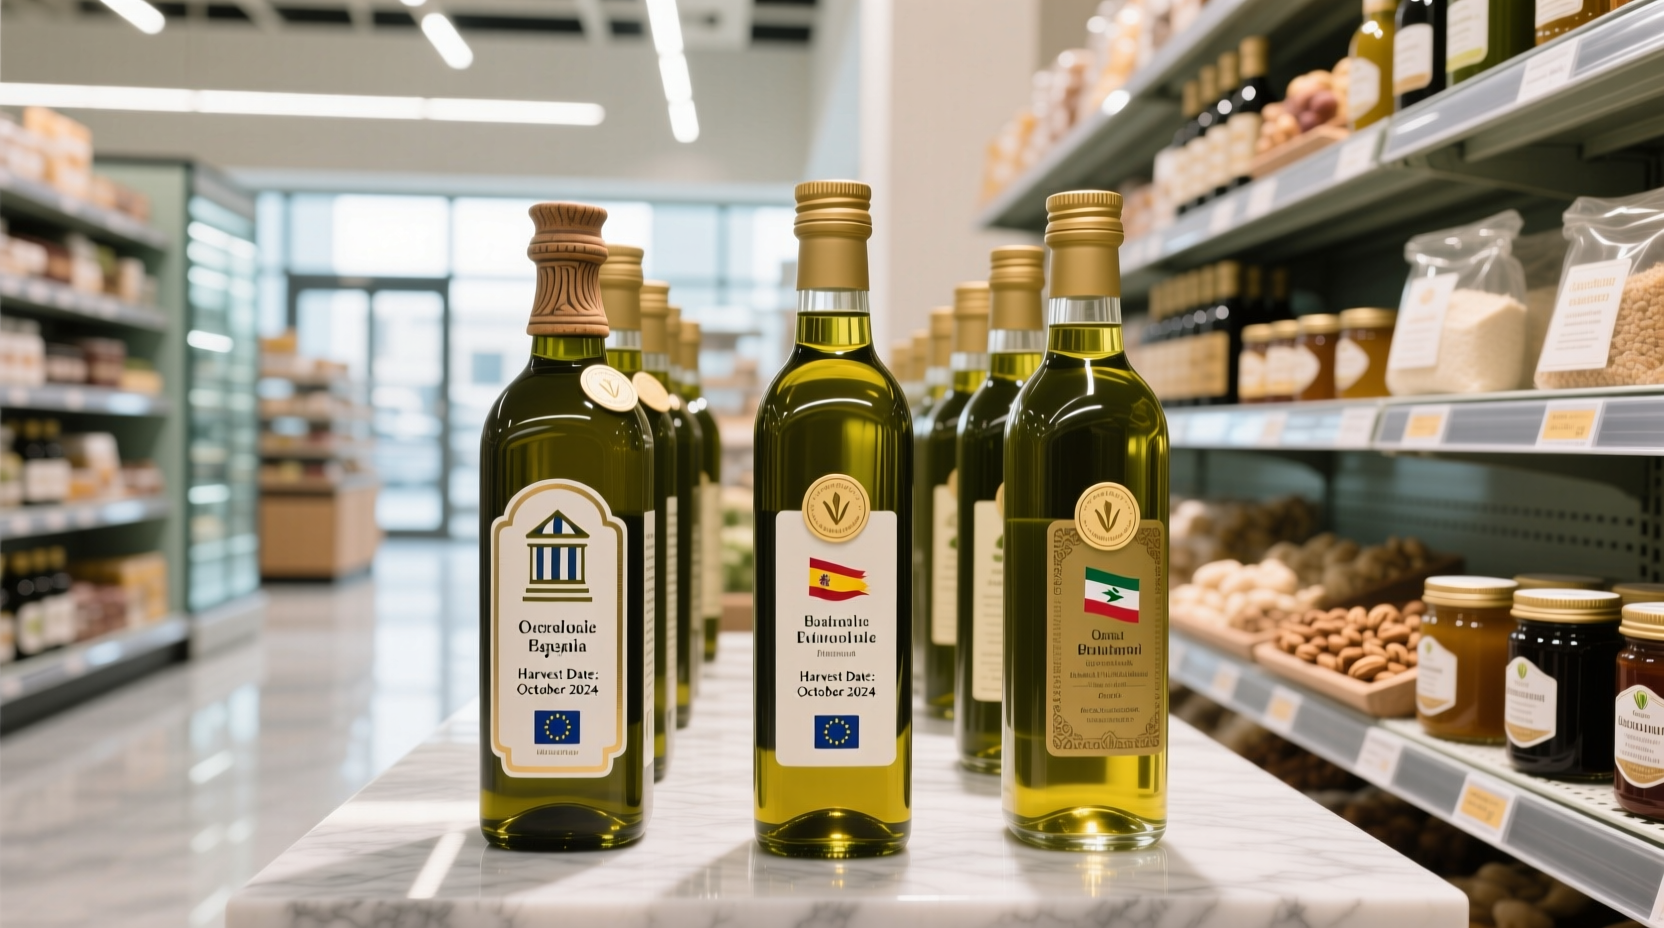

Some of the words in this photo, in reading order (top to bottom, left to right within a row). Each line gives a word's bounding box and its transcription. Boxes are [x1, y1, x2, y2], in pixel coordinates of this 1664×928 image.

[518, 667, 563, 680] Harvest
[566, 668, 599, 680] Date:
[800, 670, 842, 682] Harvest
[846, 670, 875, 682] Date:
[516, 682, 566, 695] October
[569, 684, 599, 696] 2024
[797, 685, 845, 698] October
[847, 686, 876, 698] 2024
